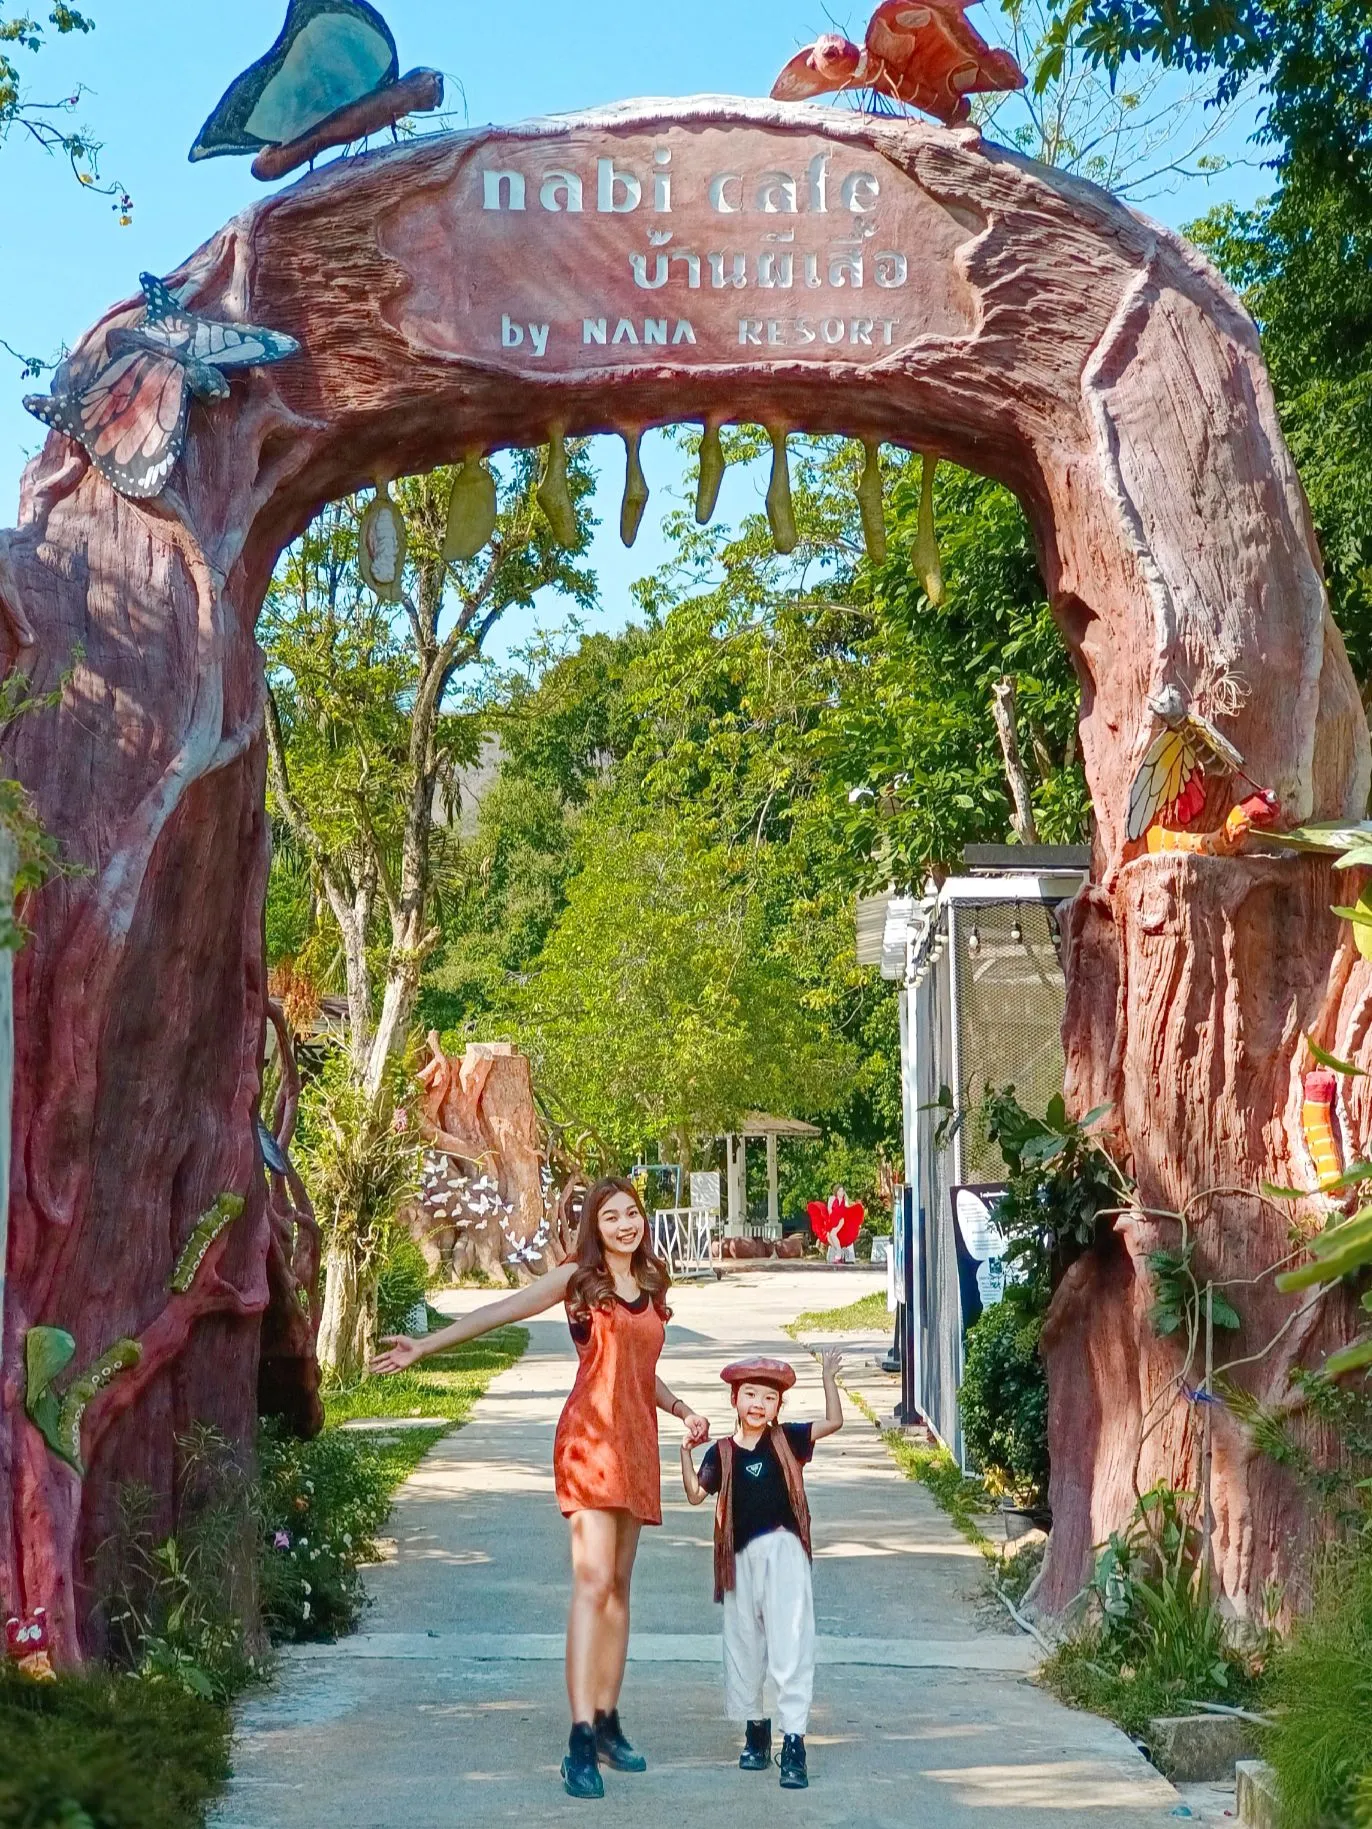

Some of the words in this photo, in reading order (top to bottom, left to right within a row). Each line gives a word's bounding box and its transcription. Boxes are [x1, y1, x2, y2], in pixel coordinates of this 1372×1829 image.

[483, 146, 673, 213] nabi
[710, 152, 881, 213] cafe
[628, 215, 908, 289] บ้านผีเสื้อ
[501, 313, 549, 357] by
[583, 317, 697, 345] NANA
[738, 317, 900, 346] RESORT
